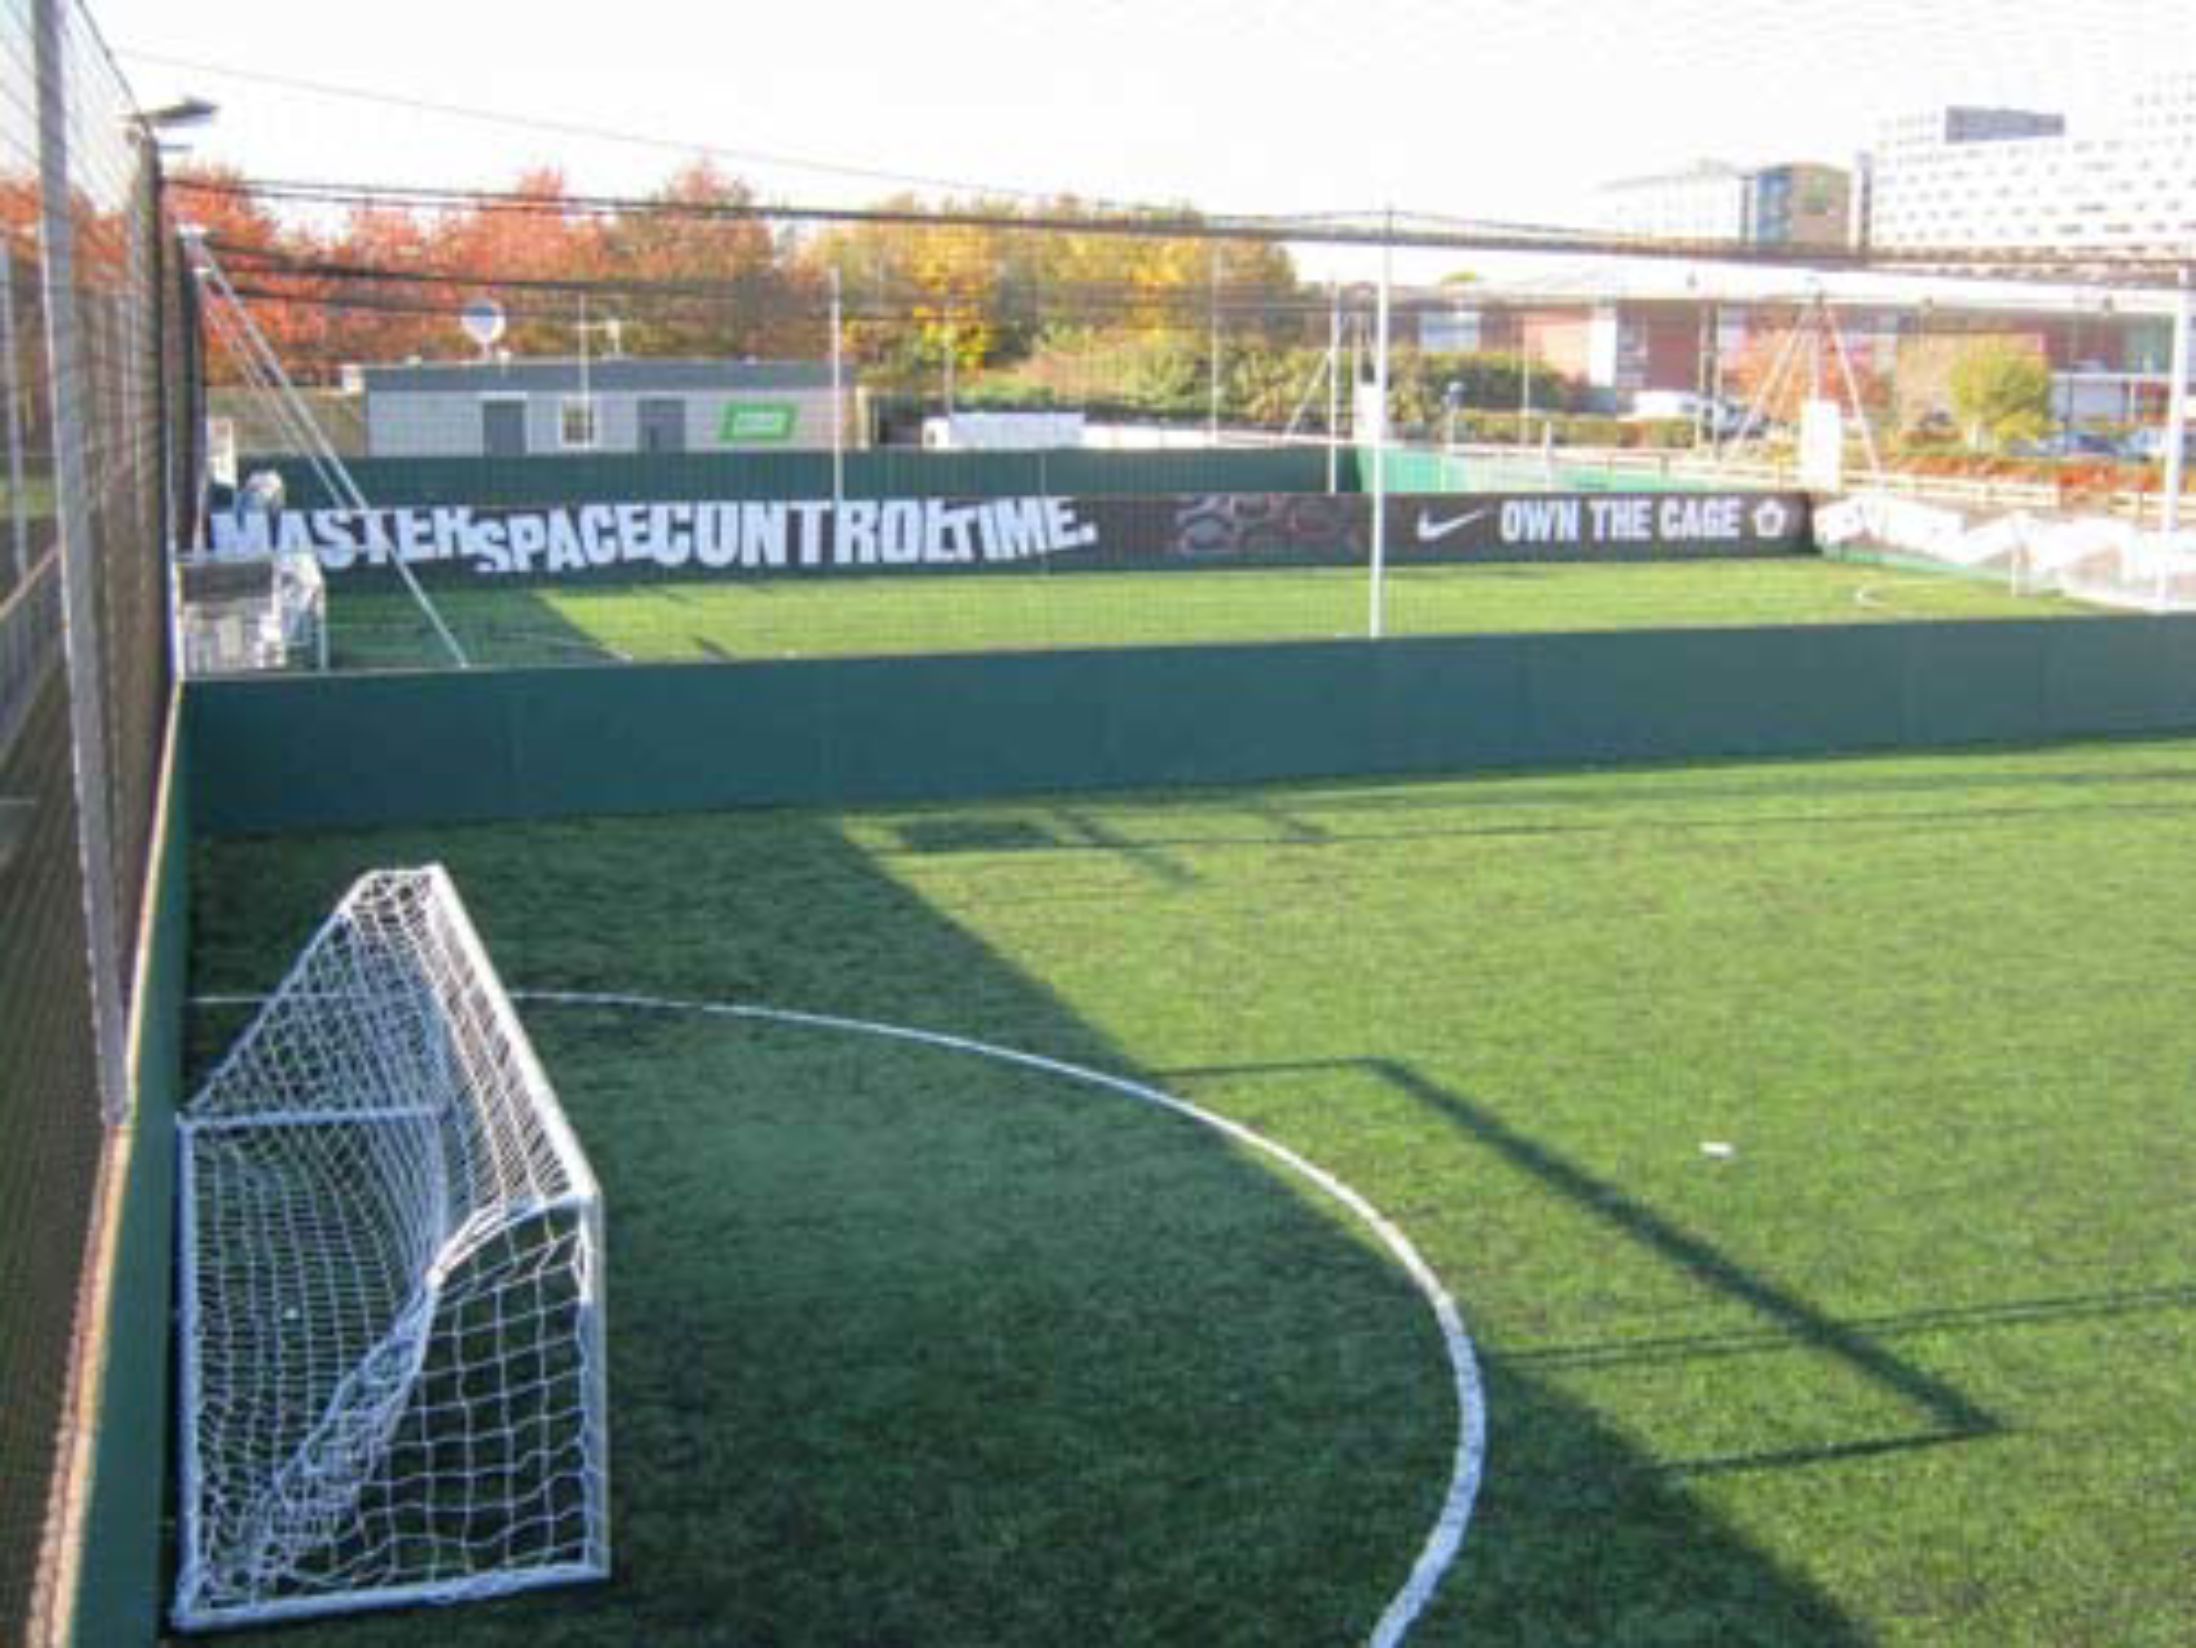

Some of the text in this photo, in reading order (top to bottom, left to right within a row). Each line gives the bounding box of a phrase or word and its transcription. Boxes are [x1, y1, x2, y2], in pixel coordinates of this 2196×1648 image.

[473, 502, 649, 572] SPACE
[1500, 497, 1741, 542] OWN THE CAGE
